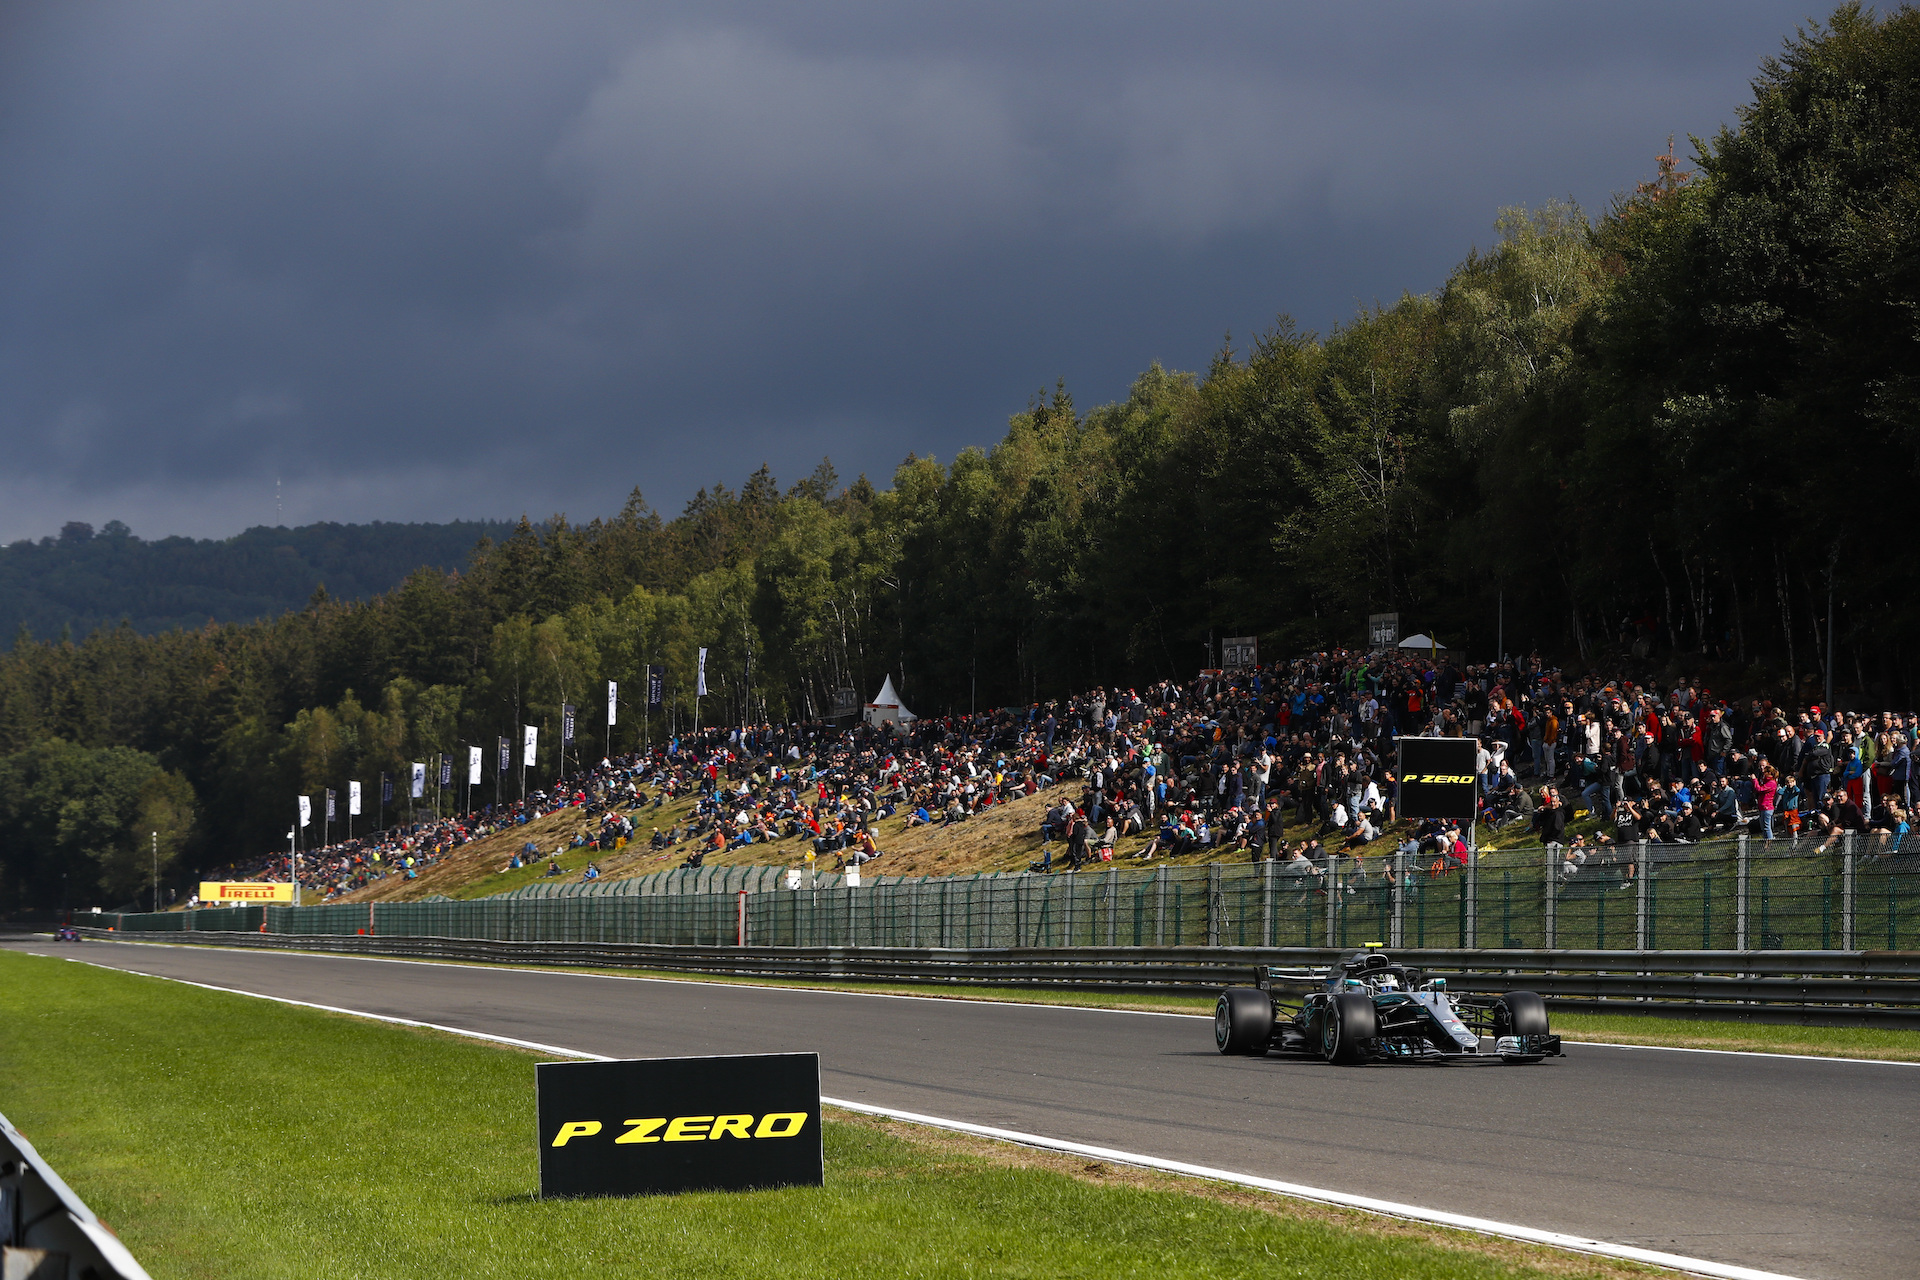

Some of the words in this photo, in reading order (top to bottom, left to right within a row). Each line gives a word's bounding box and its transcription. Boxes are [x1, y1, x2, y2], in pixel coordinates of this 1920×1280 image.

[1402, 774, 1418, 783] P
[1419, 774, 1475, 784] ZERO
[220, 885, 275, 898] PIRELLI
[551, 1120, 603, 1148] P
[614, 1111, 809, 1144] ZERO
